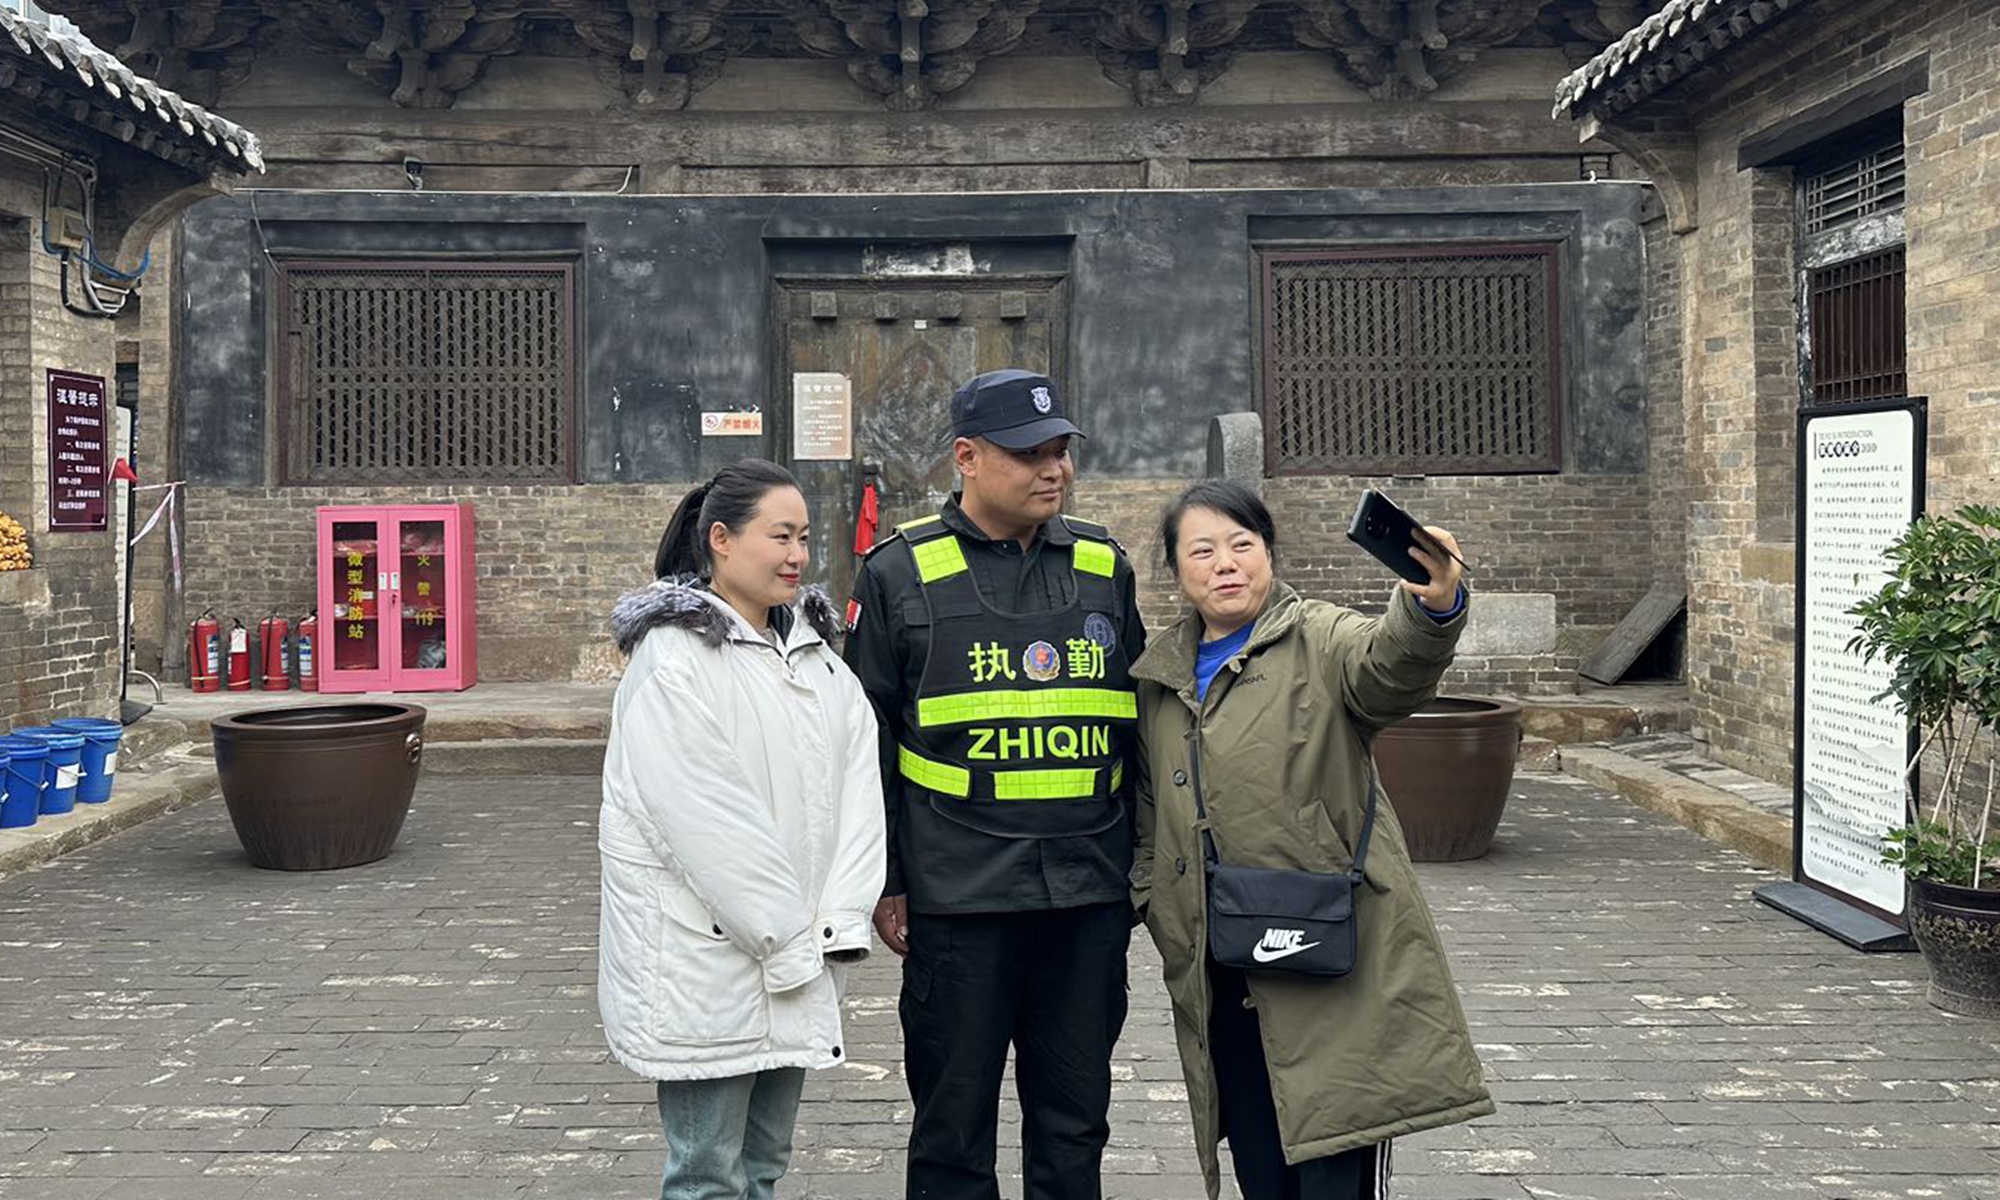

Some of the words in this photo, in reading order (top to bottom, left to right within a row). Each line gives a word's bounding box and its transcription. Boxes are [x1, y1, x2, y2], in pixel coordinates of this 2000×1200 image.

[347, 553, 364, 639] 微型消防站
[415, 612, 434, 626] 119
[967, 725, 1110, 760] ZHIQIN
[1261, 928, 1306, 949] NIKE
